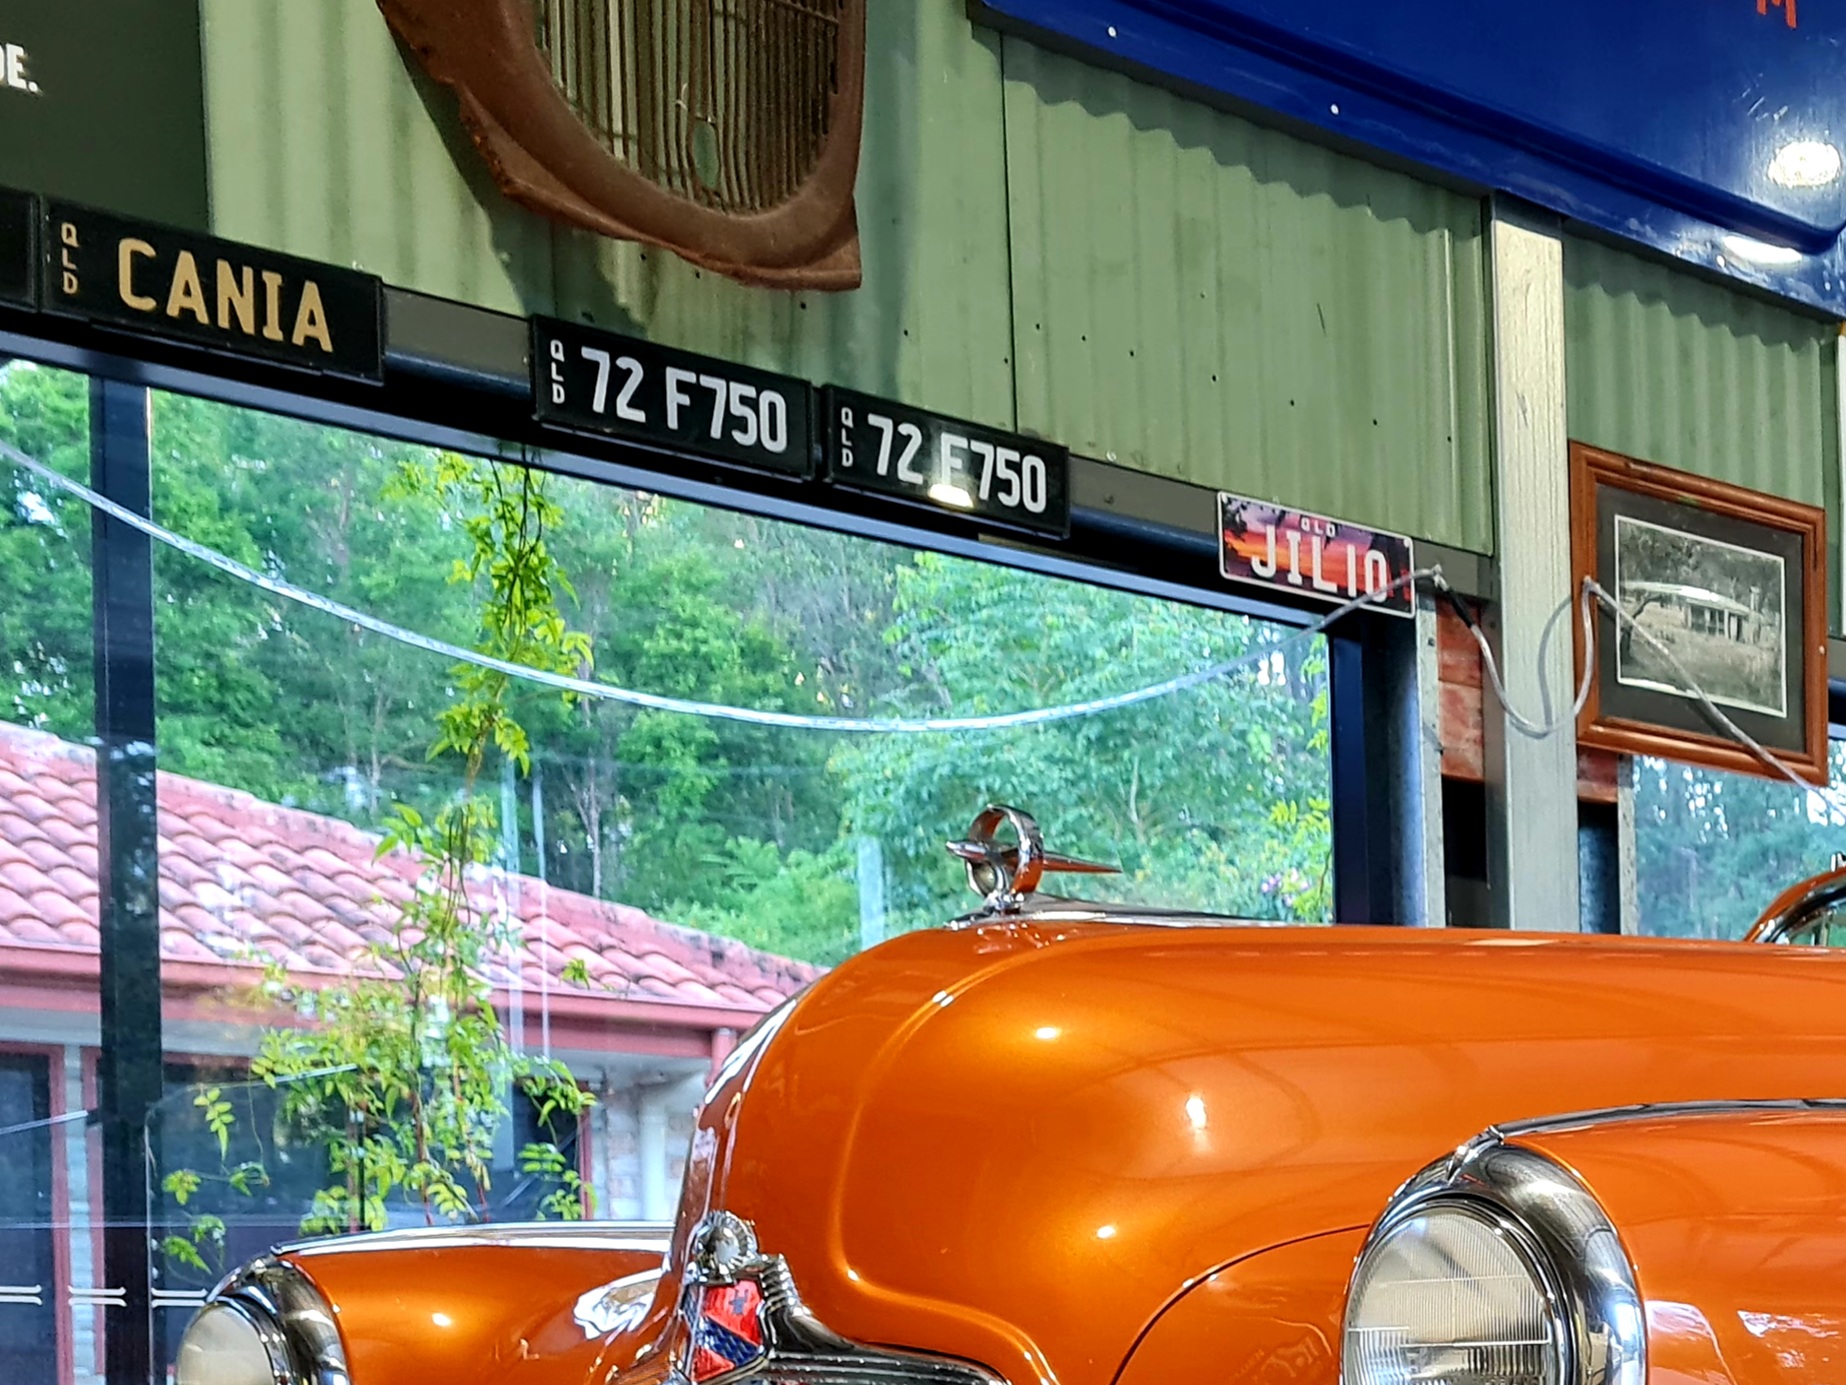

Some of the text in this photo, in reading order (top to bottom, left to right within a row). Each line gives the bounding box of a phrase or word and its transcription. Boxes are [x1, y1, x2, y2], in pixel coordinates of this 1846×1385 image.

[118, 237, 334, 353] CANIA
[580, 346, 788, 454] 72 F750
[867, 413, 925, 485] 72
